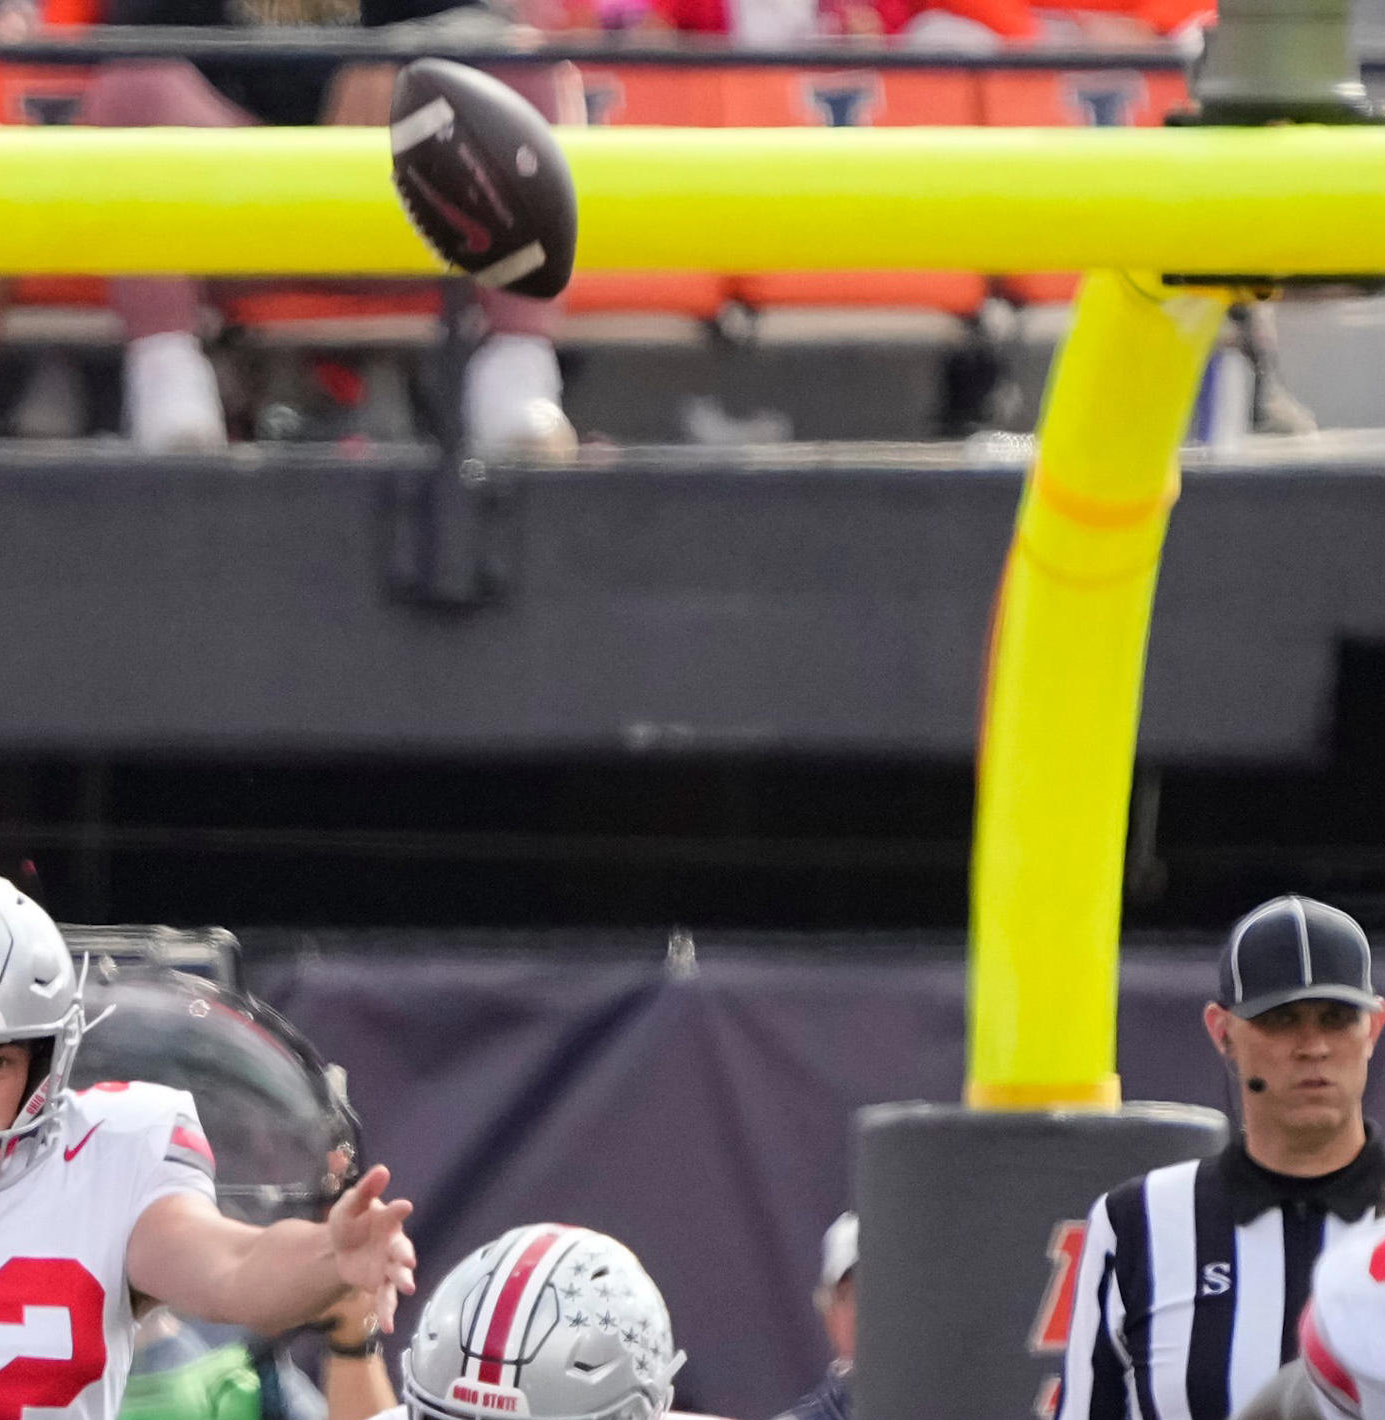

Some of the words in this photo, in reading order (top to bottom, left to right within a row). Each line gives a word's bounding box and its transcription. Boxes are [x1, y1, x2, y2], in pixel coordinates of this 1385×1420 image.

[25, 1094, 47, 1116] OHIO
[1202, 1262, 1231, 1296] S
[452, 1385, 480, 1405] OHIO
[482, 1392, 519, 1412] STATE
